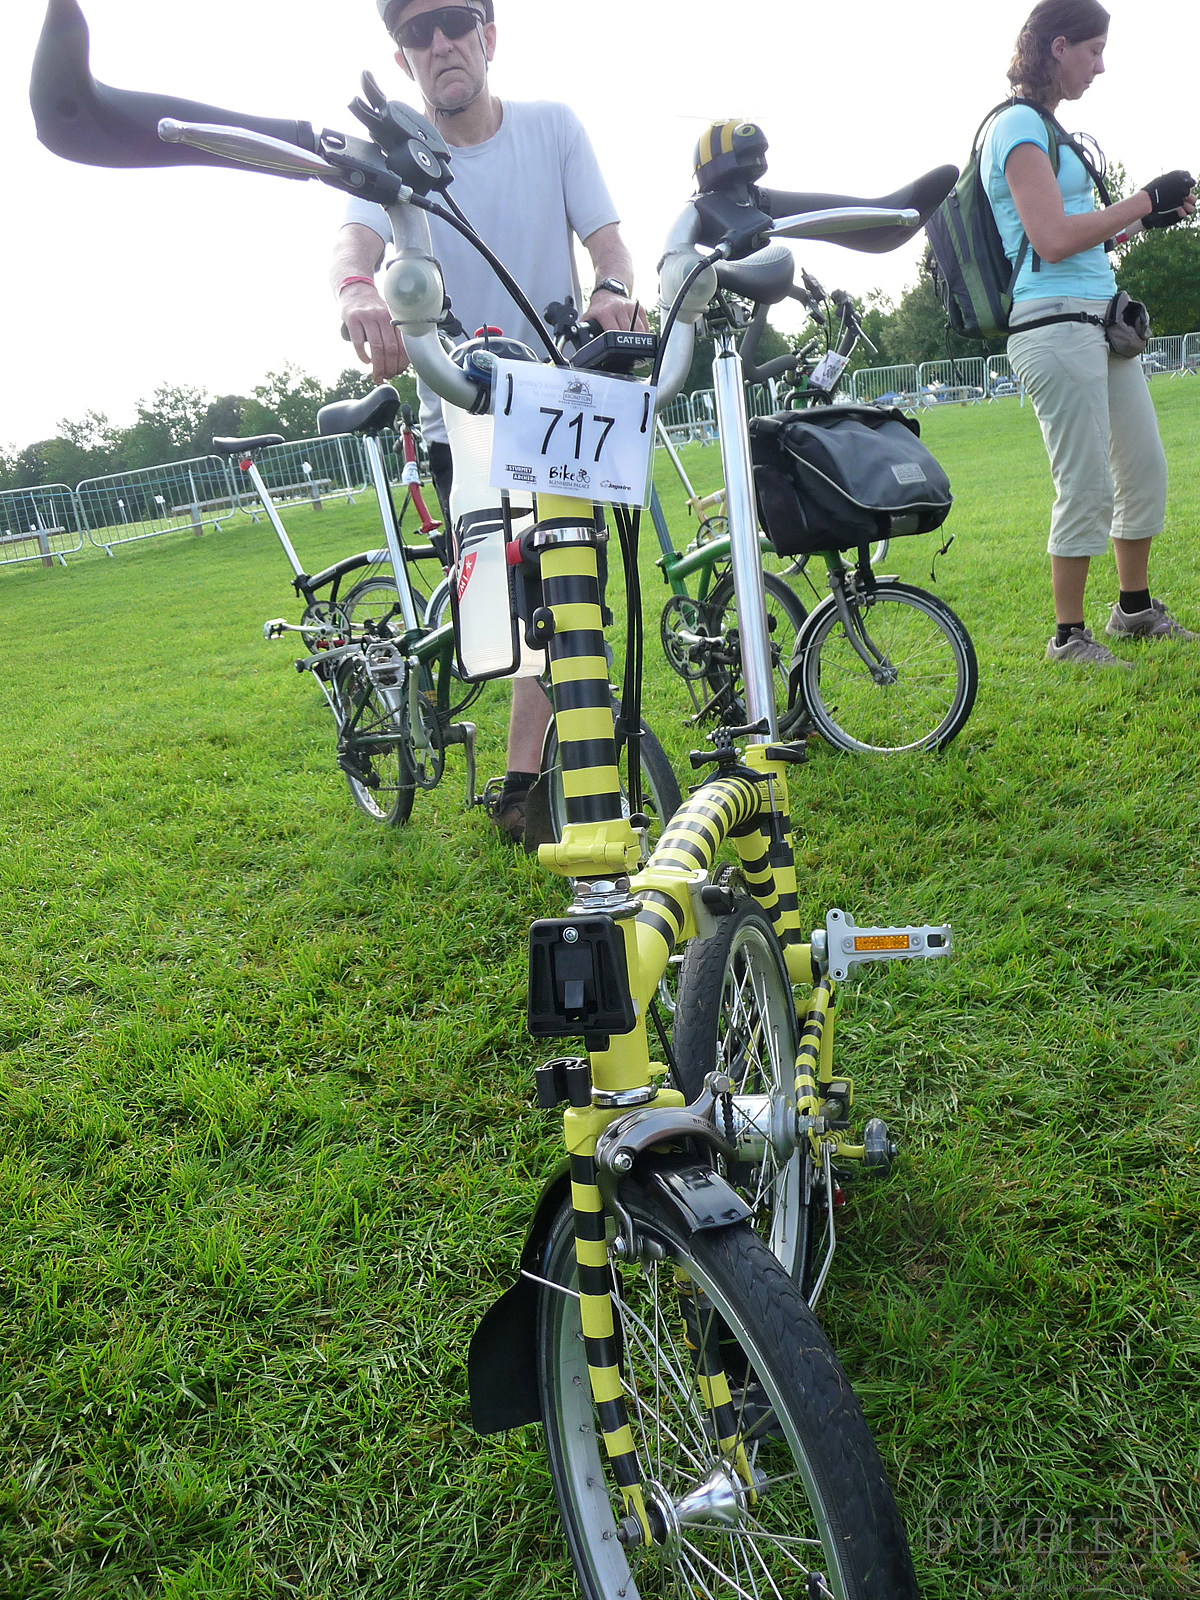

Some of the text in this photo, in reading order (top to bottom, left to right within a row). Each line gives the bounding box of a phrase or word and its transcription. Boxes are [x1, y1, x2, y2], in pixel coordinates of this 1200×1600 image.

[616, 335, 653, 345] CATEYE
[539, 406, 616, 463] 717
[549, 464, 576, 481] Bike
